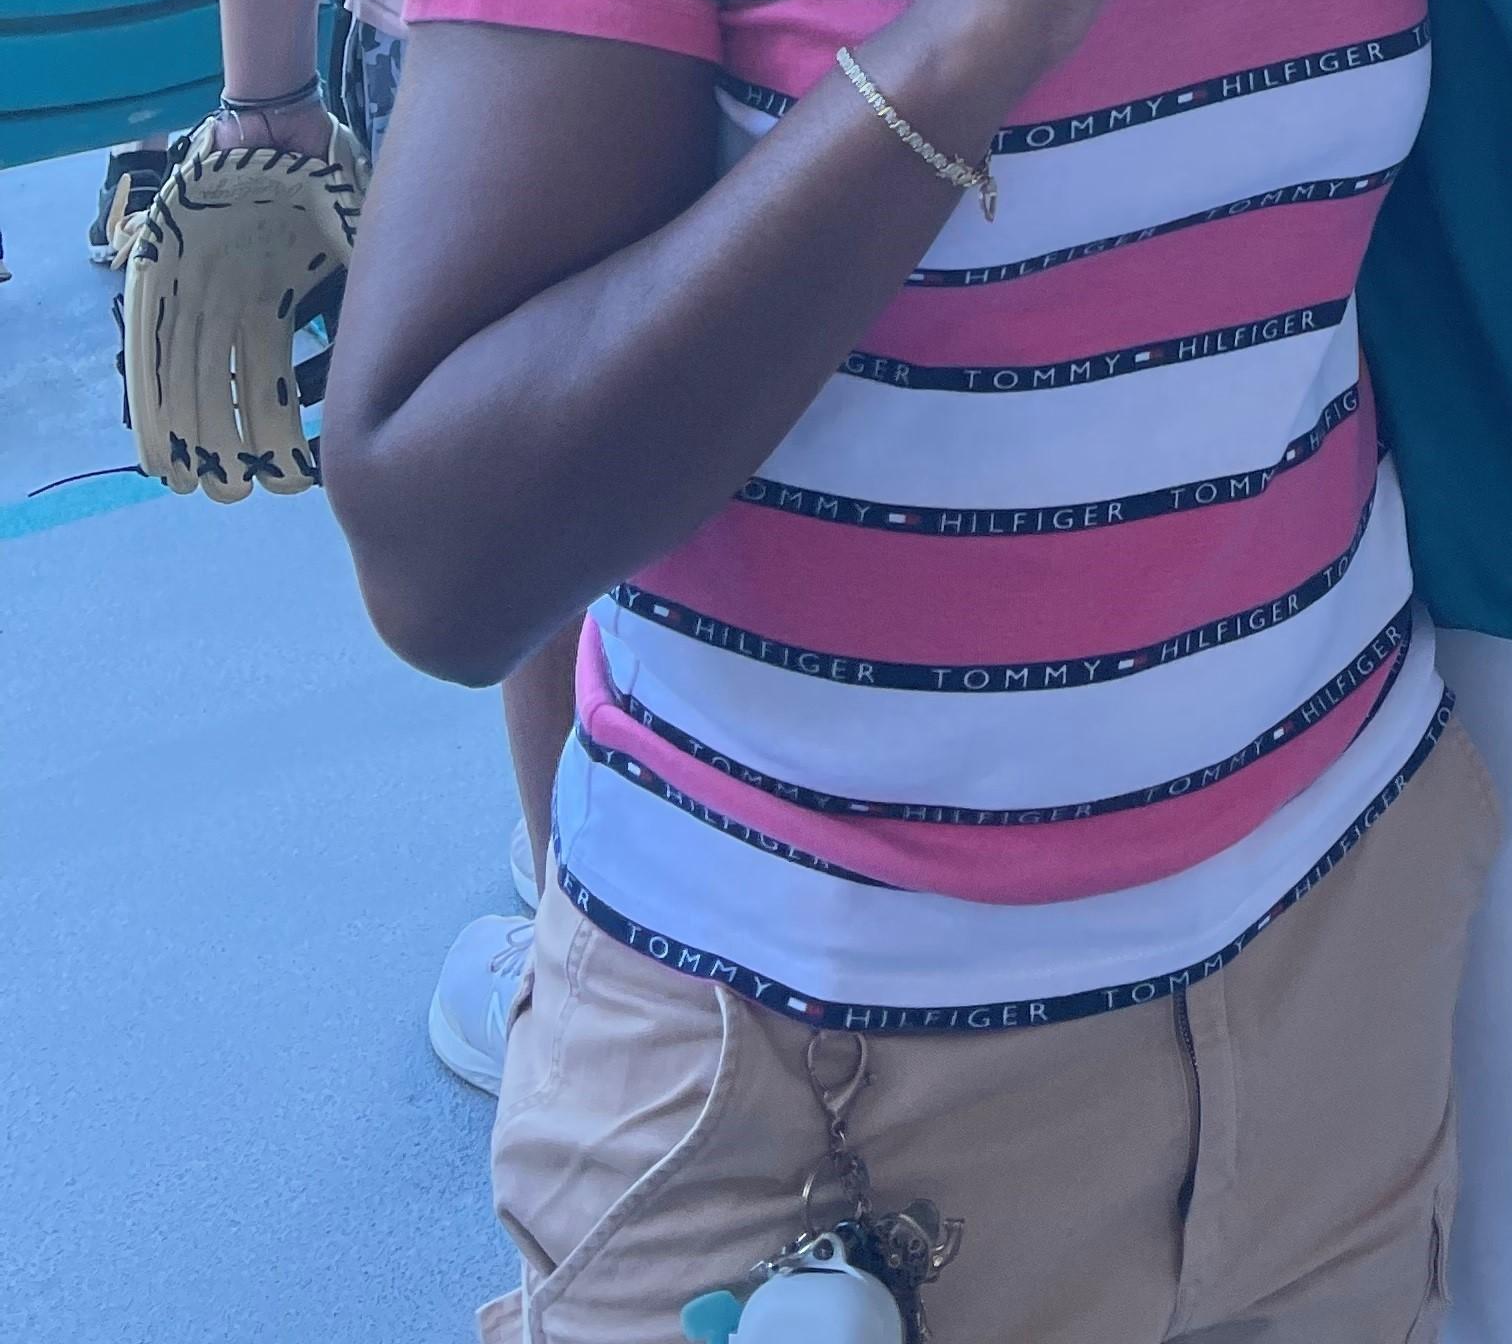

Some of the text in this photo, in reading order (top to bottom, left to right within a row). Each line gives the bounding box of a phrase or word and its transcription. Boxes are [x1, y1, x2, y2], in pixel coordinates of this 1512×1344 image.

[997, 41, 1385, 152] TOMMY HILFIGER
[964, 179, 1345, 285] HILFIGER TOMMY
[964, 352, 1121, 391] TOMMY
[1178, 308, 1316, 362] HILFIGER
[740, 478, 873, 524] OMMY
[938, 501, 1125, 534] HILFIGER
[695, 592, 1300, 692] HILFIGER TOMMY HILFIGER
[687, 739, 831, 809] TOMMY
[902, 802, 1093, 827] HILFIGER
[1143, 738, 1264, 804] TOMMY
[1301, 623, 1403, 726] HILFIGER
[624, 773, 1408, 1030] TOMMY HILFIGER TOMMY HILFIGER
